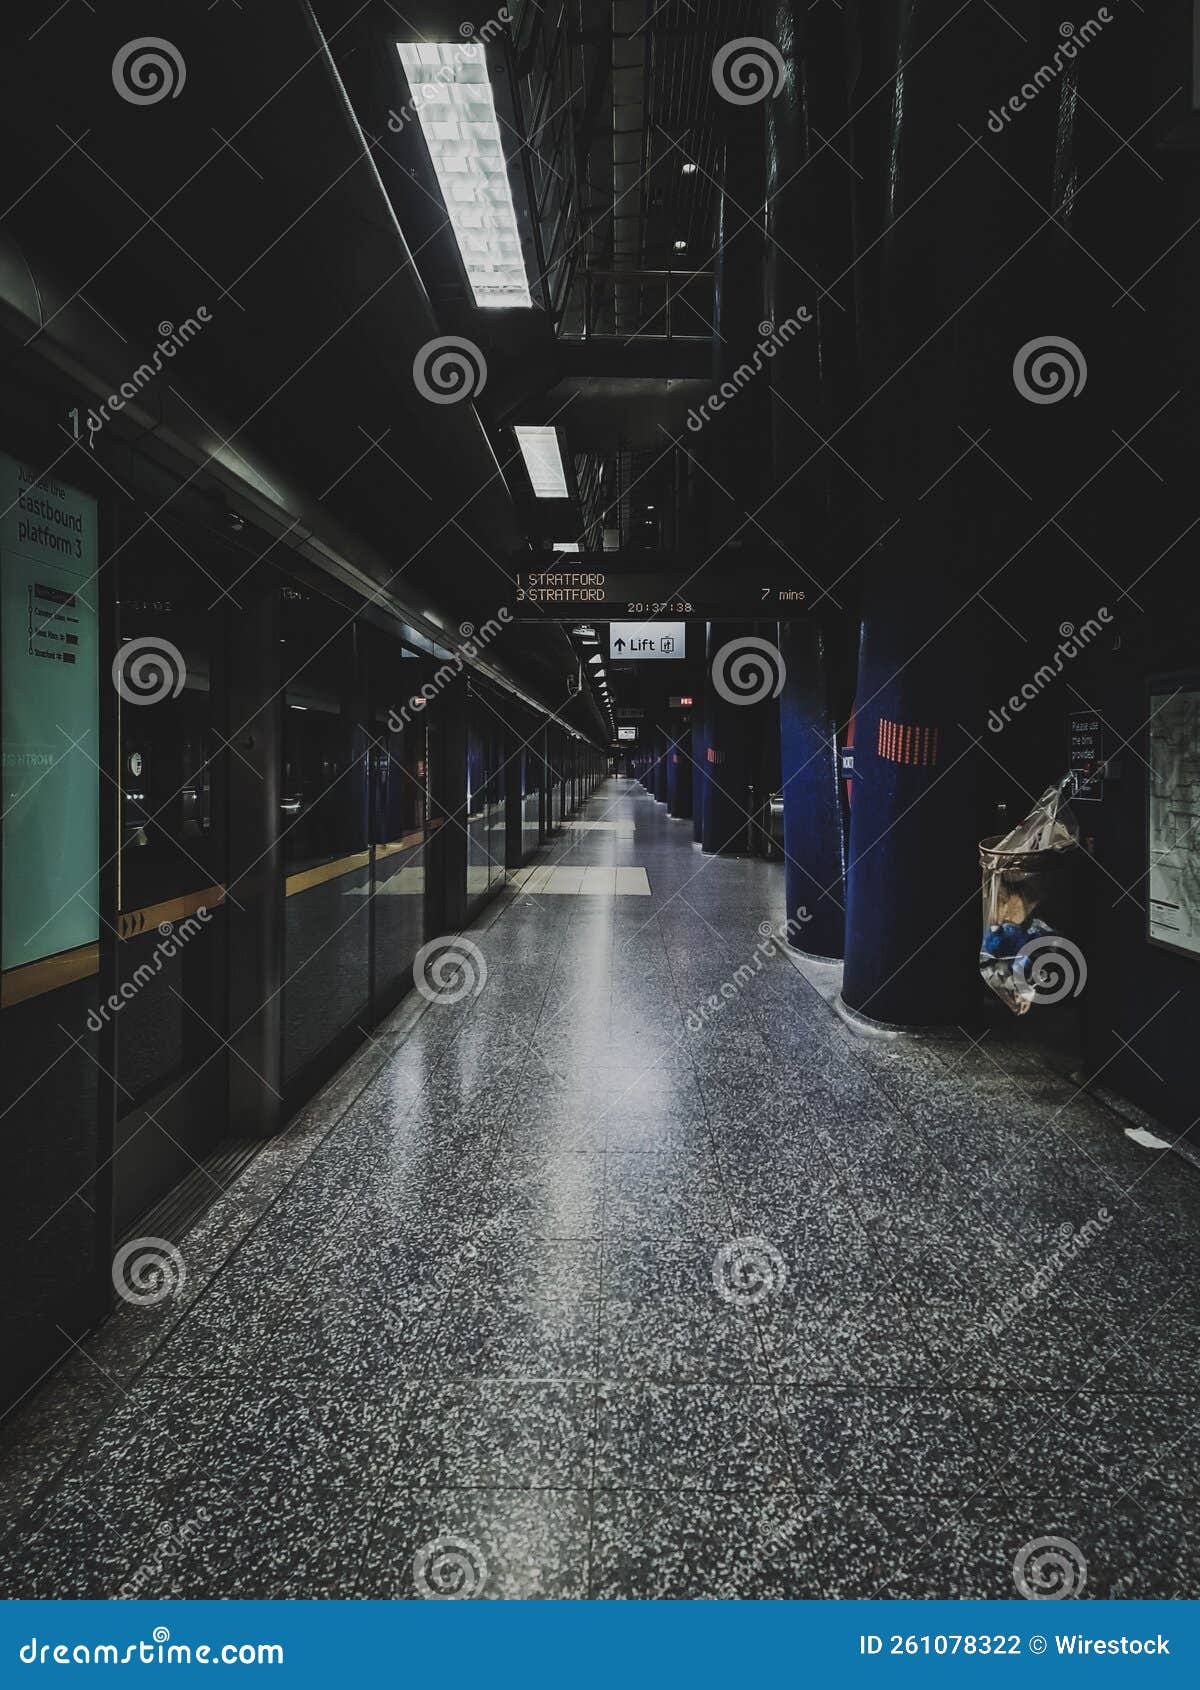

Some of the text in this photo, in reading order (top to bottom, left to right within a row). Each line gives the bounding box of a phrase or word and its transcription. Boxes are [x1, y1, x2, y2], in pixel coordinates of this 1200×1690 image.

[19, 488, 82, 533] Eastbound
[19, 519, 82, 558] platform 3
[528, 573, 605, 586] STRATFORD
[516, 588, 806, 601] 3 STRATFORD 7 mins
[627, 602, 693, 613] 20:37:38
[630, 639, 655, 651] Lift
